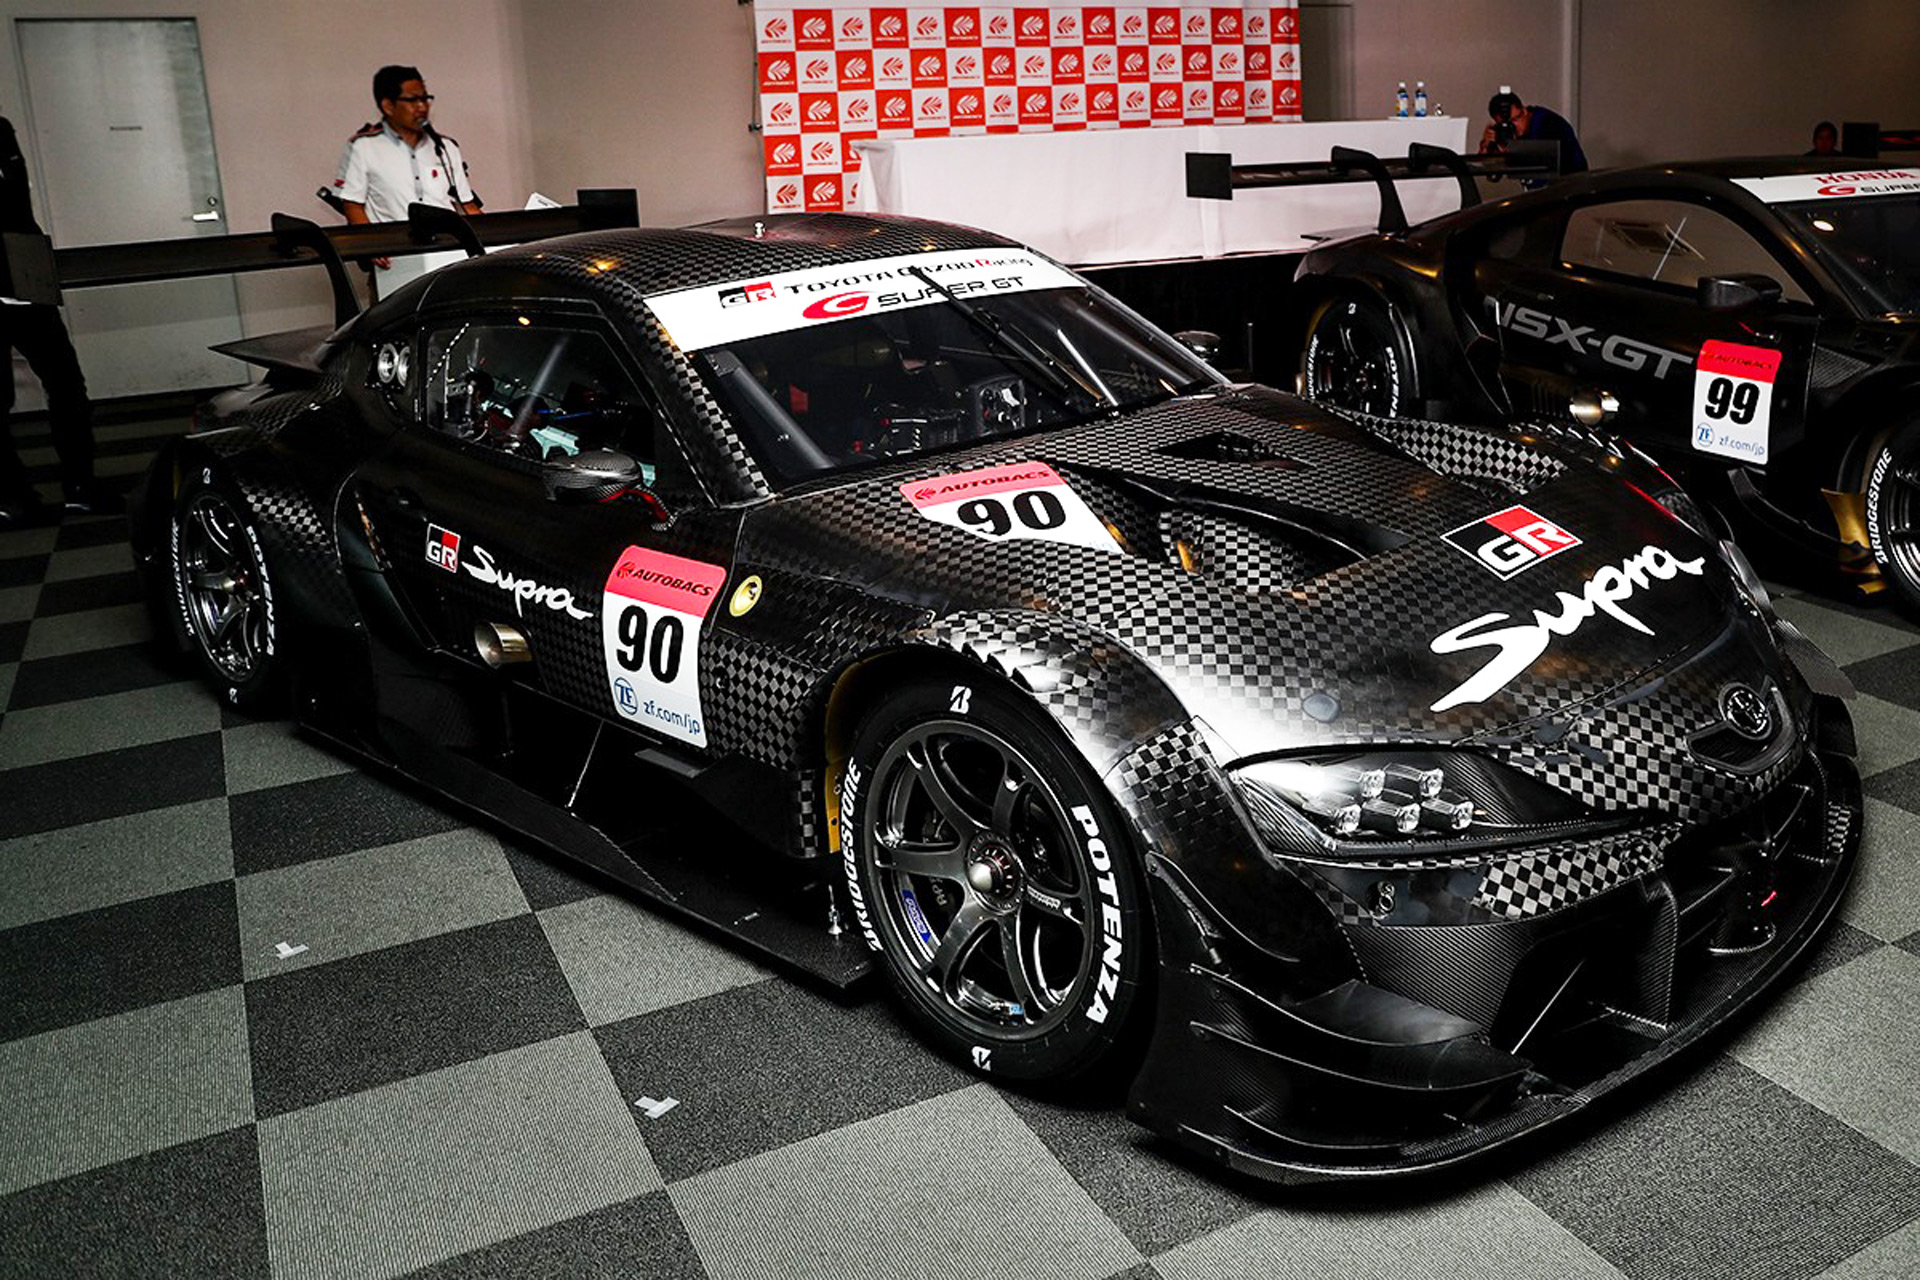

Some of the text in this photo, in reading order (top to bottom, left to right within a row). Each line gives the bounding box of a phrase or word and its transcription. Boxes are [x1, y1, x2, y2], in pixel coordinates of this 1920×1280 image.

[1812, 171, 1919, 184] HONDA
[784, 271, 893, 294] TOYOTA
[877, 281, 988, 307] SUPER
[991, 276, 1023, 289] GT
[1705, 377, 1760, 426] 99
[940, 470, 1050, 494] AUTOBACS
[1867, 448, 1892, 564] BRIDGESTONE
[957, 490, 1066, 537] 90
[1477, 522, 1573, 572] GR
[427, 540, 594, 620] GR Supra
[631, 568, 714, 597] AUTOBACS
[616, 604, 684, 684] 90
[1429, 545, 1705, 712] Supra
[643, 700, 701, 735] zf.com/jp
[841, 757, 884, 951] BRIDGESTONE
[1071, 804, 1123, 1023] POTENZA
